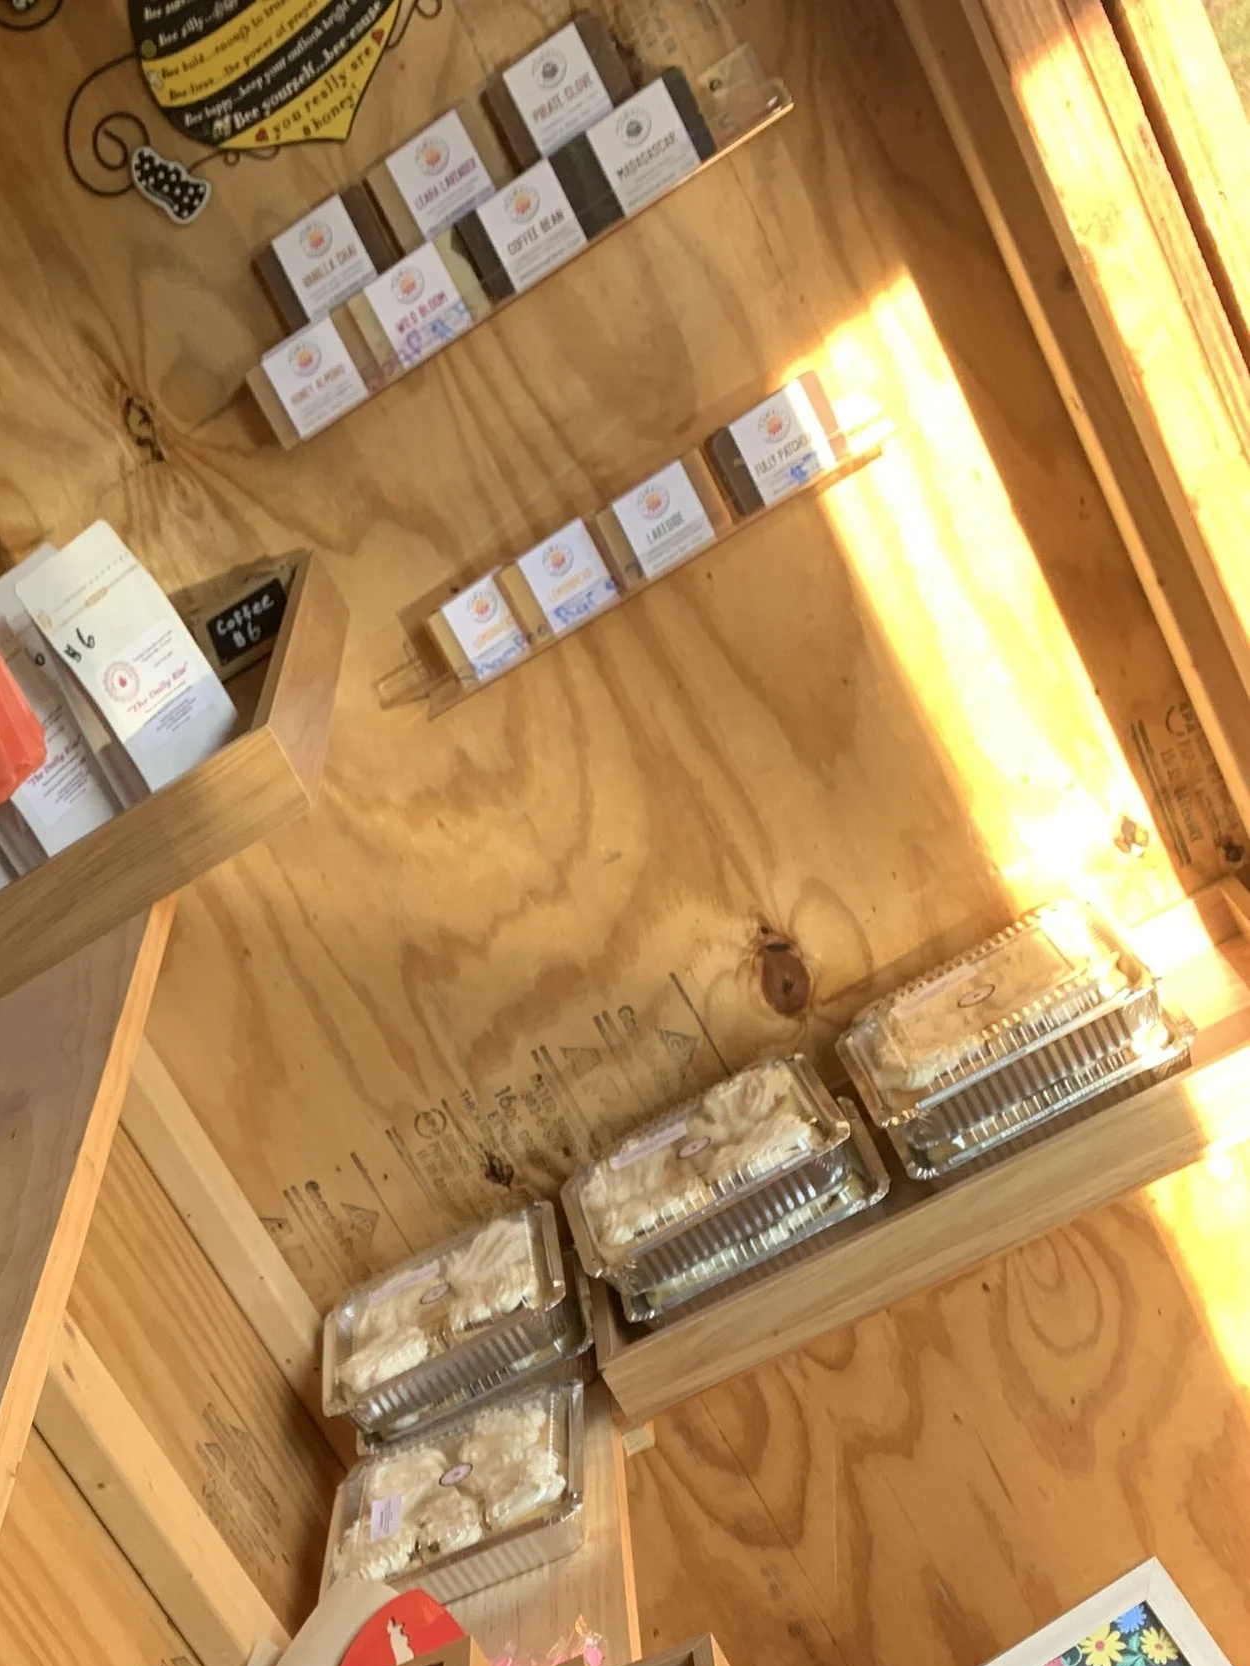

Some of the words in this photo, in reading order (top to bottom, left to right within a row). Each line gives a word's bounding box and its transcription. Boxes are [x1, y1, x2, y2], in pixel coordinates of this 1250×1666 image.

[270, 107, 303, 138] you
[300, 63, 349, 114] really
[348, 43, 373, 71] are
[505, 224, 540, 255] COFFEE
[538, 207, 565, 233] BEAN
[211, 589, 276, 637] Coffee
